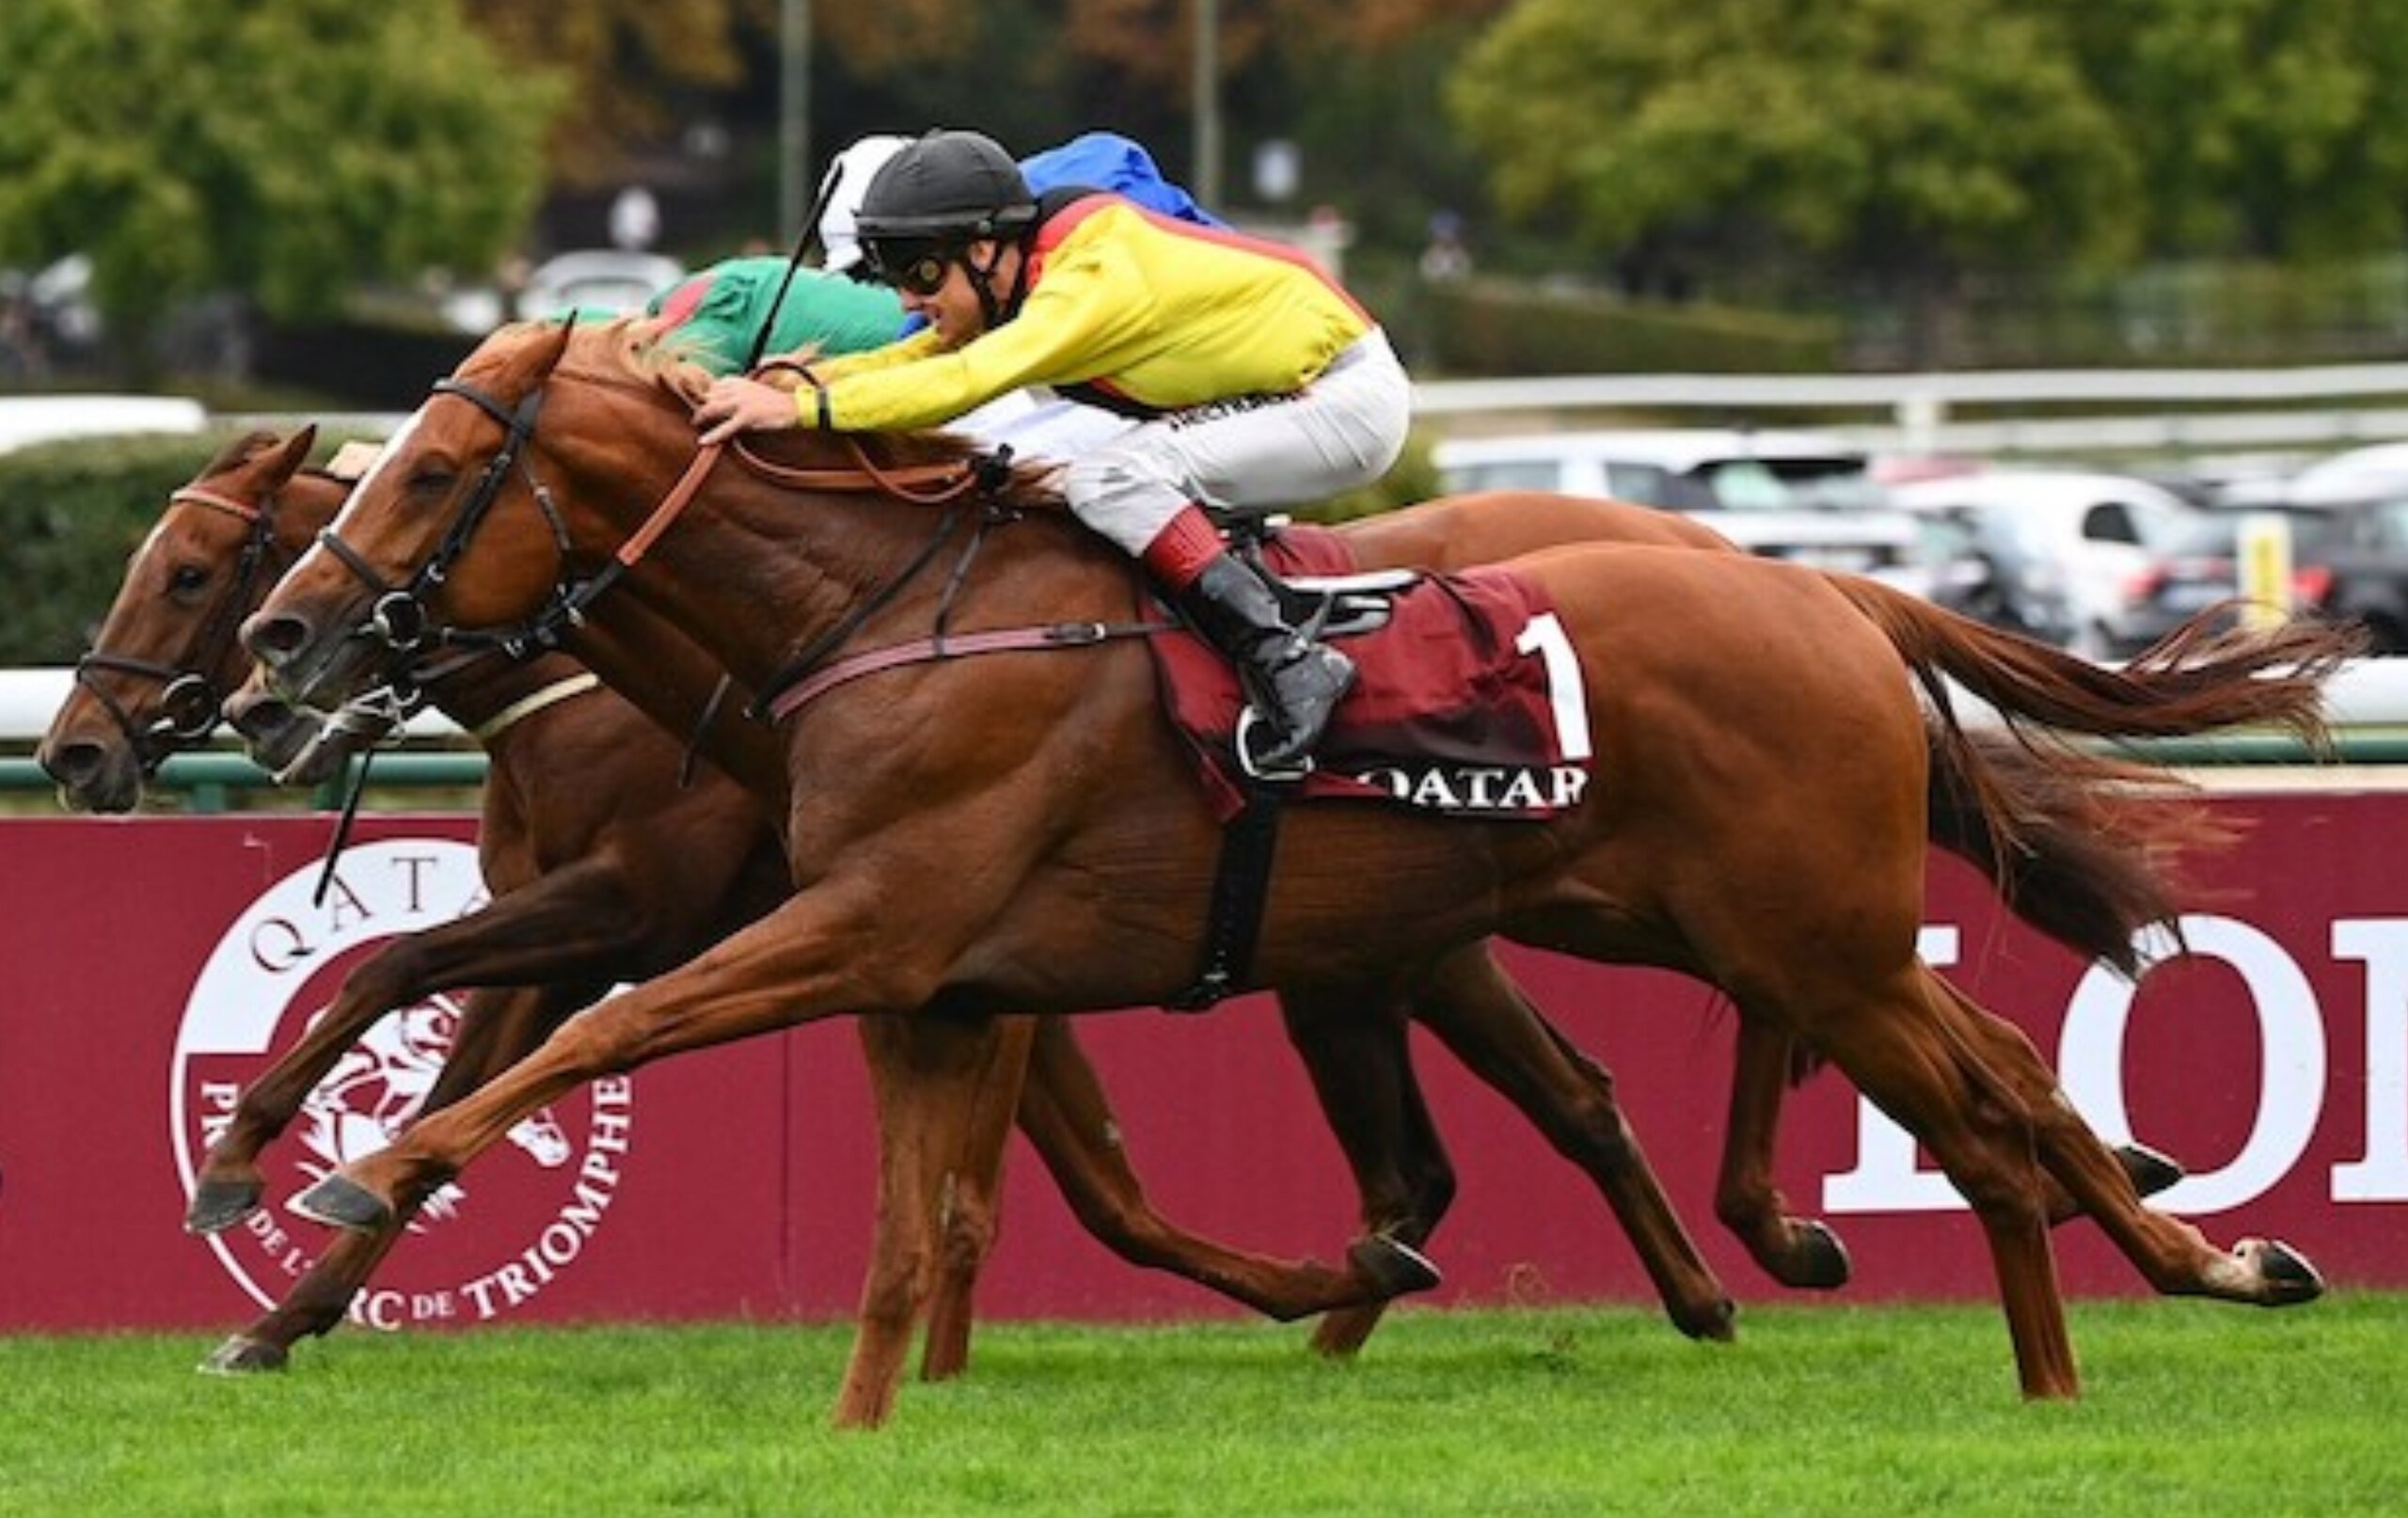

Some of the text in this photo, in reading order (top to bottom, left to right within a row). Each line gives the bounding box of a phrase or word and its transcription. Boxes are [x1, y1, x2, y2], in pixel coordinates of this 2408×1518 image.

[1515, 611, 1592, 760] 1
[1354, 766, 1590, 809] QATAR
[249, 855, 493, 973] QAT
[246, 1207, 290, 1257] DE
[411, 1290, 456, 1320] DE
[459, 1074, 633, 1320] TRIOMPHE
